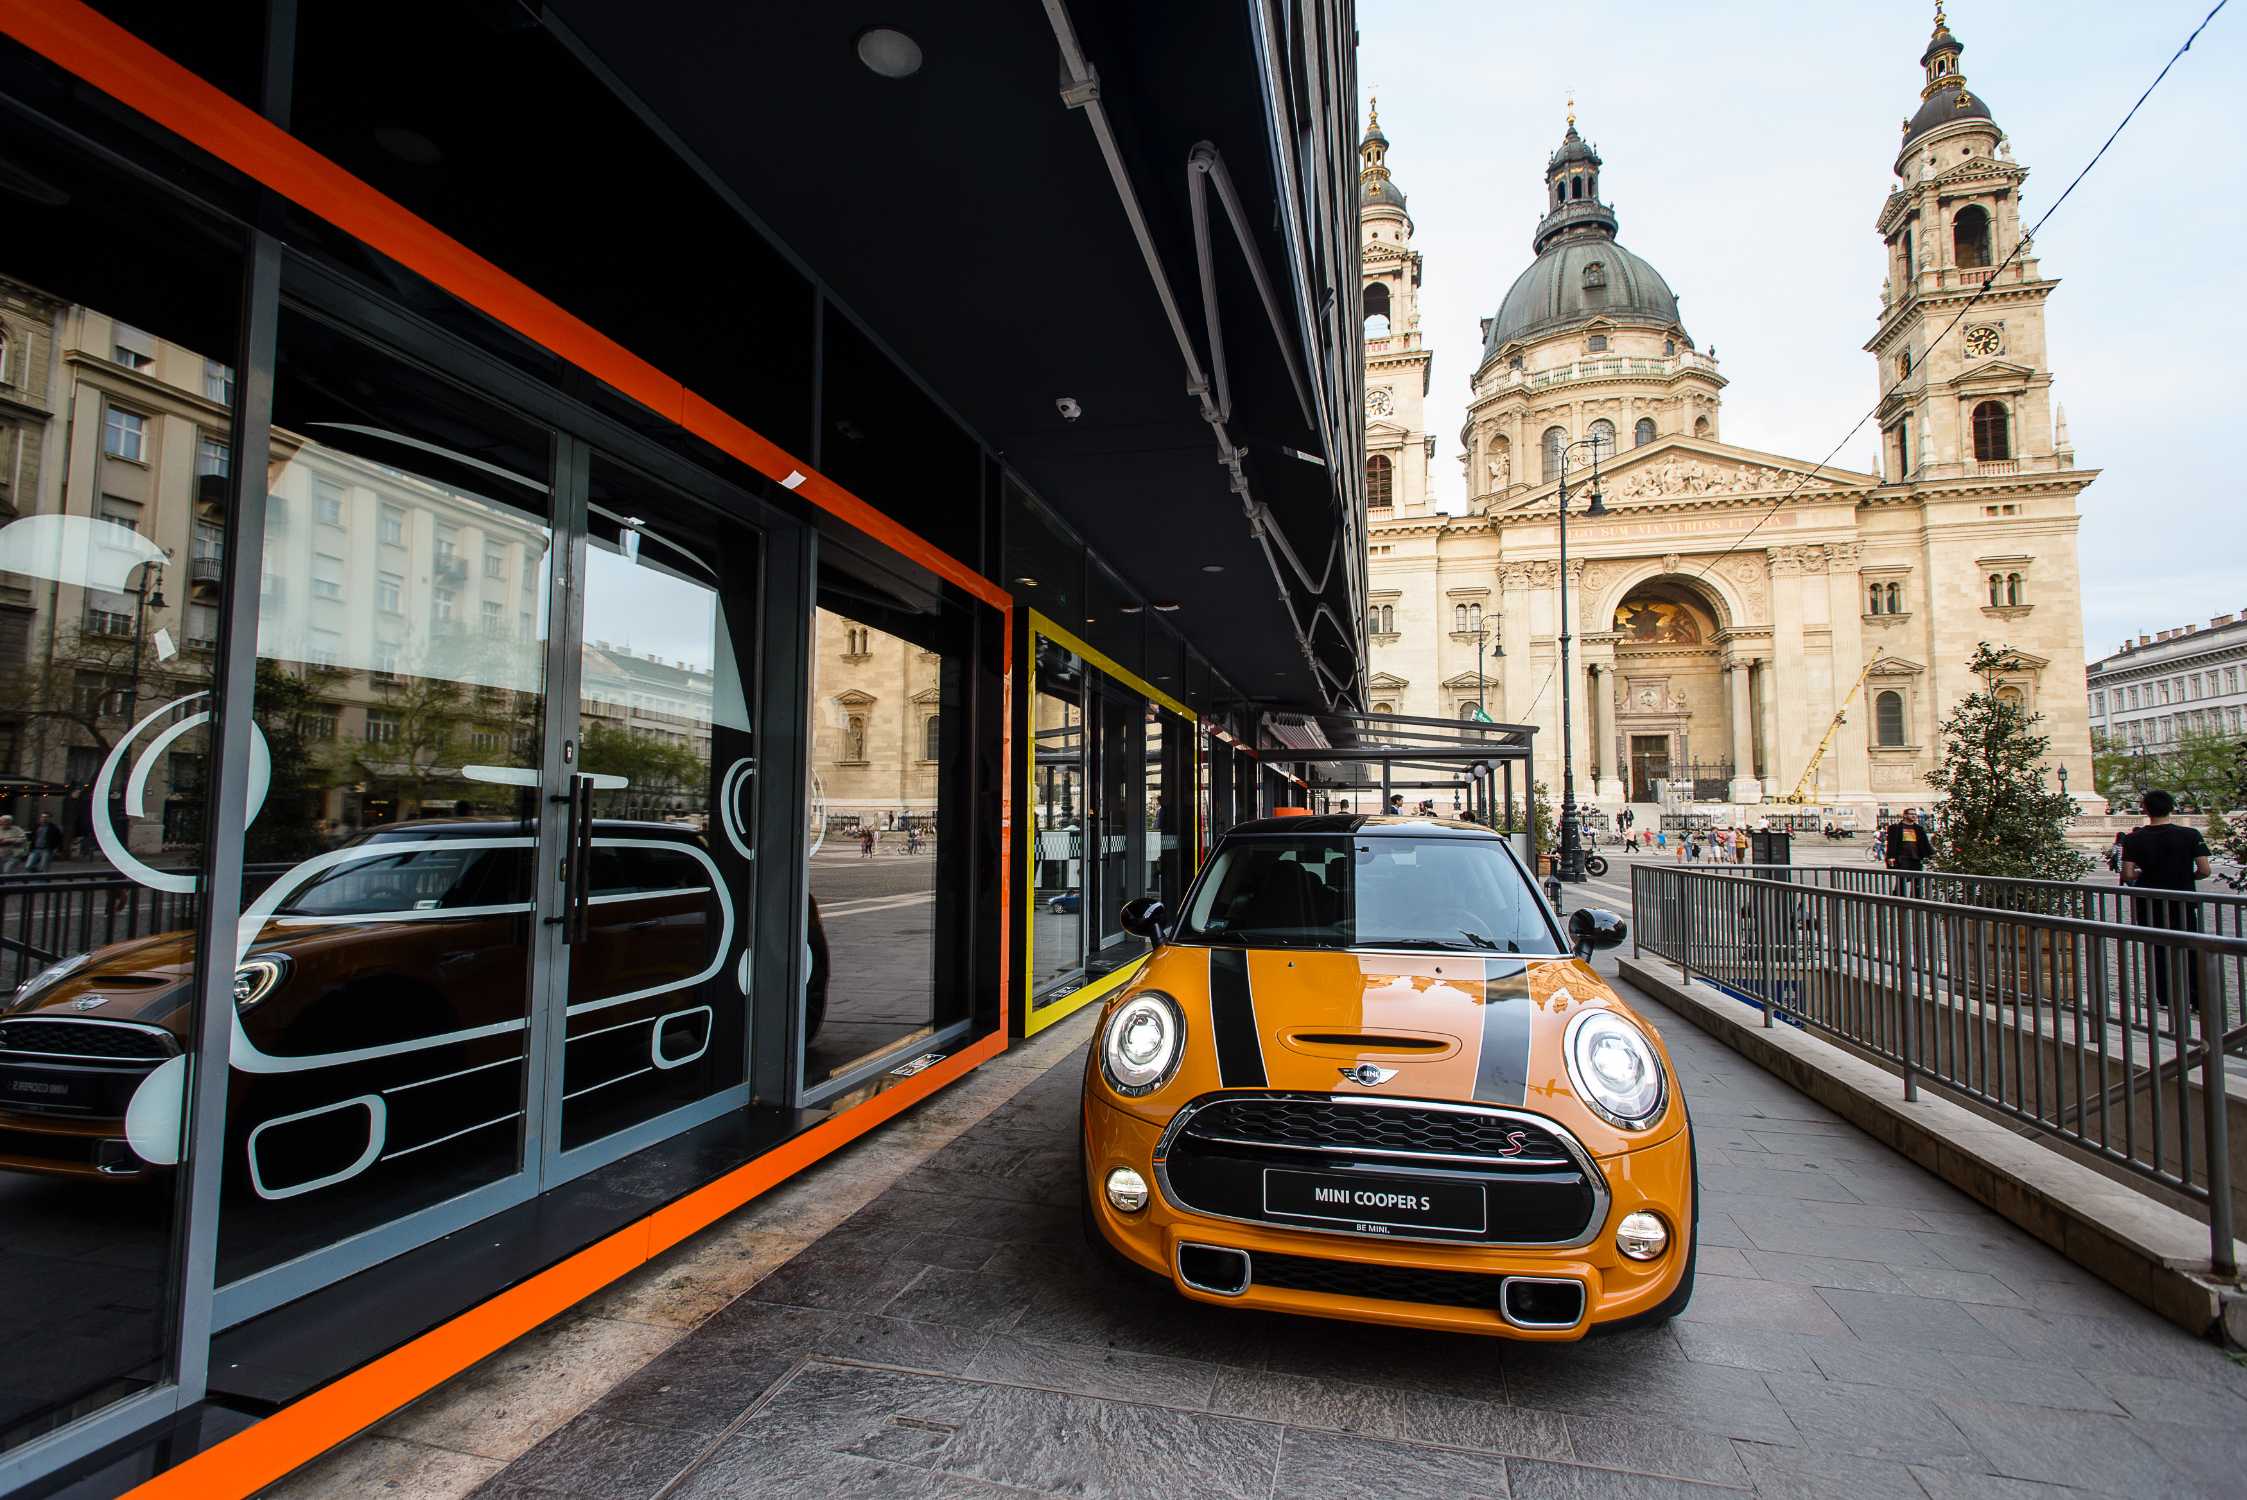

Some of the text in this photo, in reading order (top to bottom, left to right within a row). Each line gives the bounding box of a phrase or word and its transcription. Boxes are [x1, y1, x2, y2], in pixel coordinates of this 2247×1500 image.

[1600, 526, 1629, 537] SUM
[1498, 1131, 1525, 1156] S
[1315, 1187, 1431, 1211] MINI COOPER S
[1356, 1223, 1390, 1234] BE MINI.
